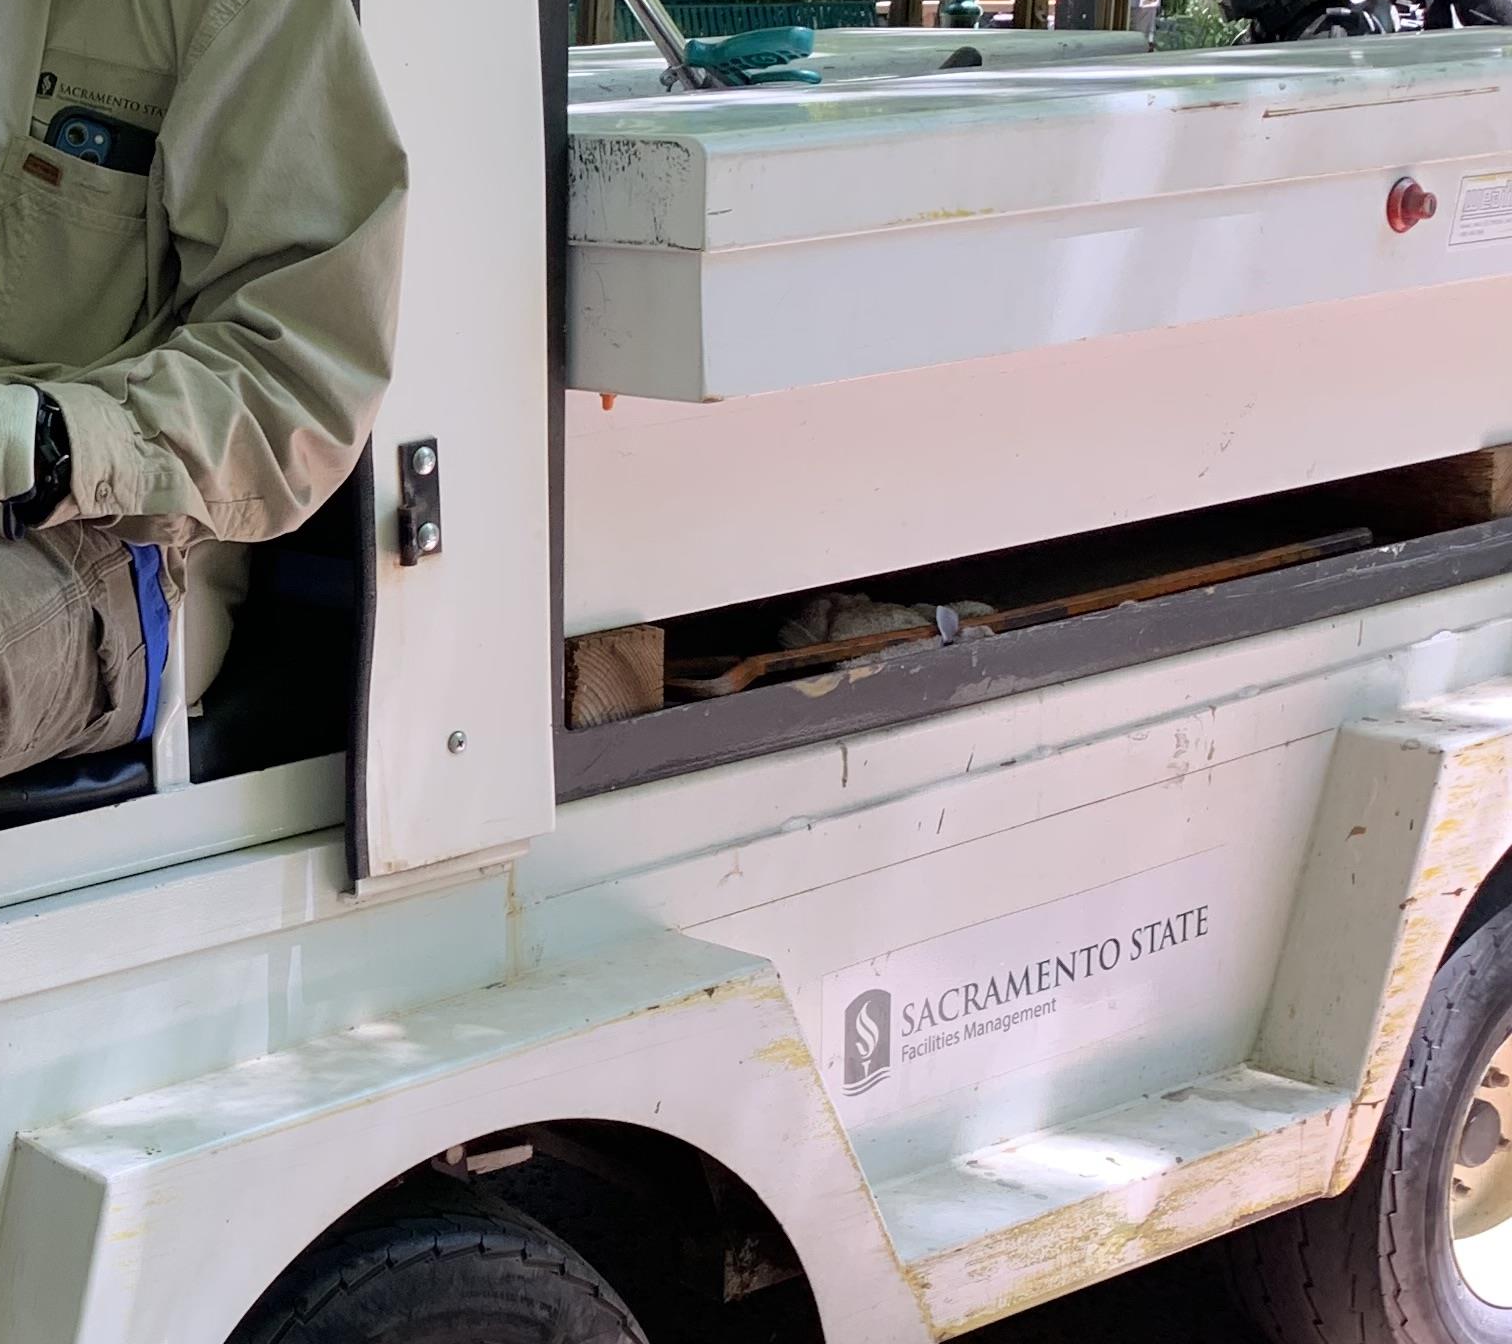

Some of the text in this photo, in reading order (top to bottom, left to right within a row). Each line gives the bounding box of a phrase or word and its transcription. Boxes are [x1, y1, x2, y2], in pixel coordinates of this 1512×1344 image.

[59, 82, 140, 113] SACRAMENTO
[142, 104, 169, 120] STA
[900, 904, 1210, 1038] SACRAMENTO STATE
[900, 997, 1058, 1064] Facilities Management
